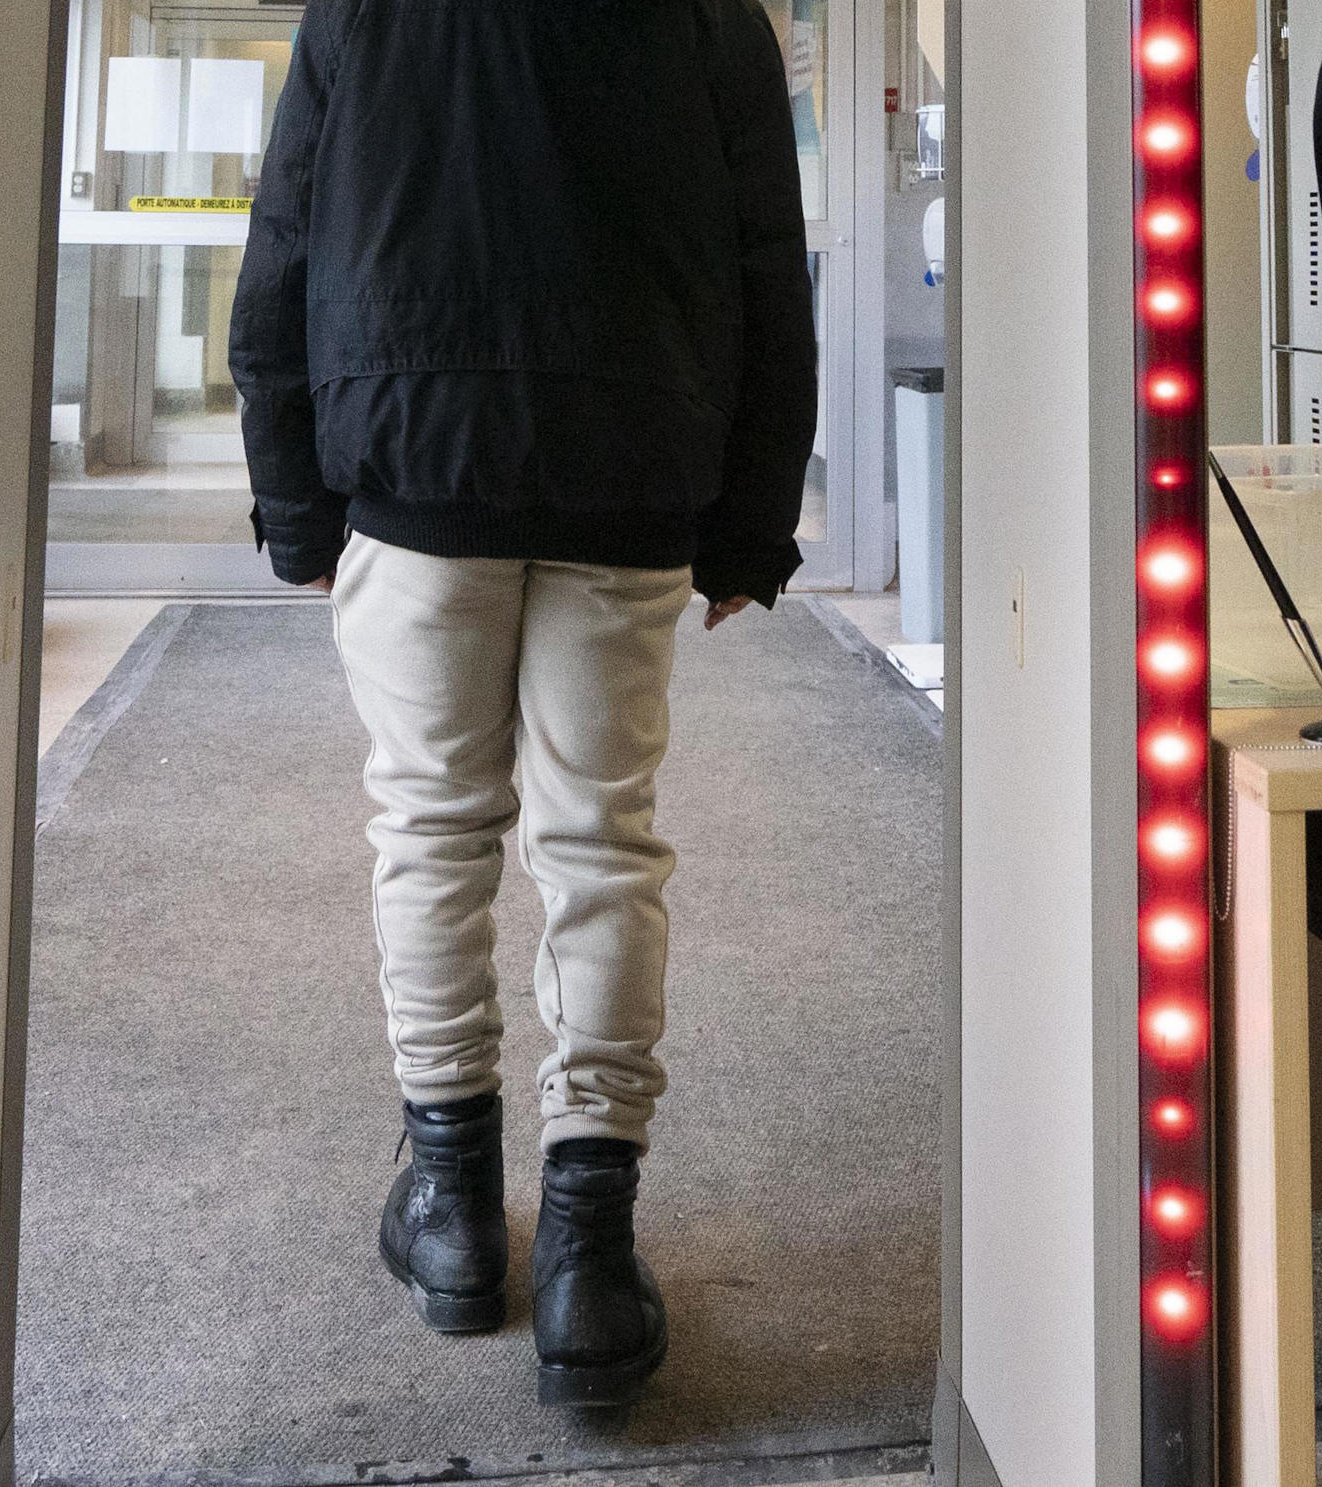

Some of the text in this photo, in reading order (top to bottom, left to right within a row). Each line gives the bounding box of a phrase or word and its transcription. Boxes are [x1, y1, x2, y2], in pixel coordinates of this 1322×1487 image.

[137, 198, 155, 208] PORTE
[156, 198, 196, 208] AUTOMATIQUE
[200, 199, 230, 209] DEMEUREZ
